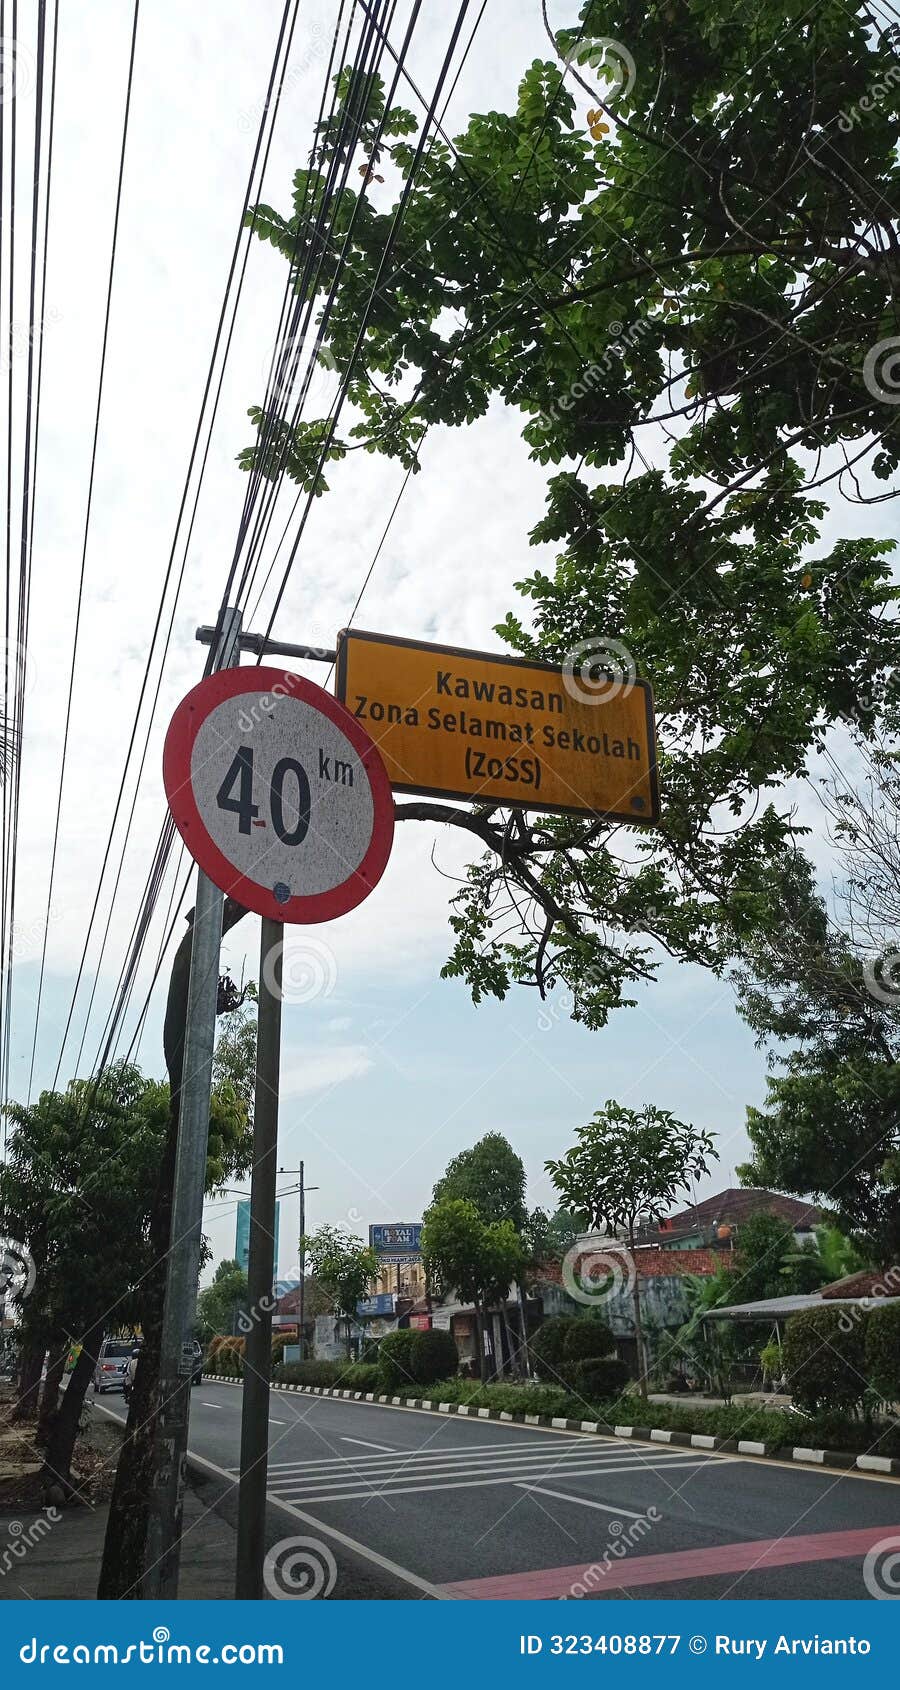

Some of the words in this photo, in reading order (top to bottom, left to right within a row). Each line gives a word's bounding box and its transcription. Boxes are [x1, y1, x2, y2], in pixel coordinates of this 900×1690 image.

[436, 670, 563, 713] Kawasan
[355, 695, 419, 727] Zona
[427, 704, 534, 745] Selamat
[542, 724, 641, 761] Sekolah
[464, 747, 541, 790] (ZoSS)
[216, 745, 311, 847] 40
[318, 748, 354, 787] km
